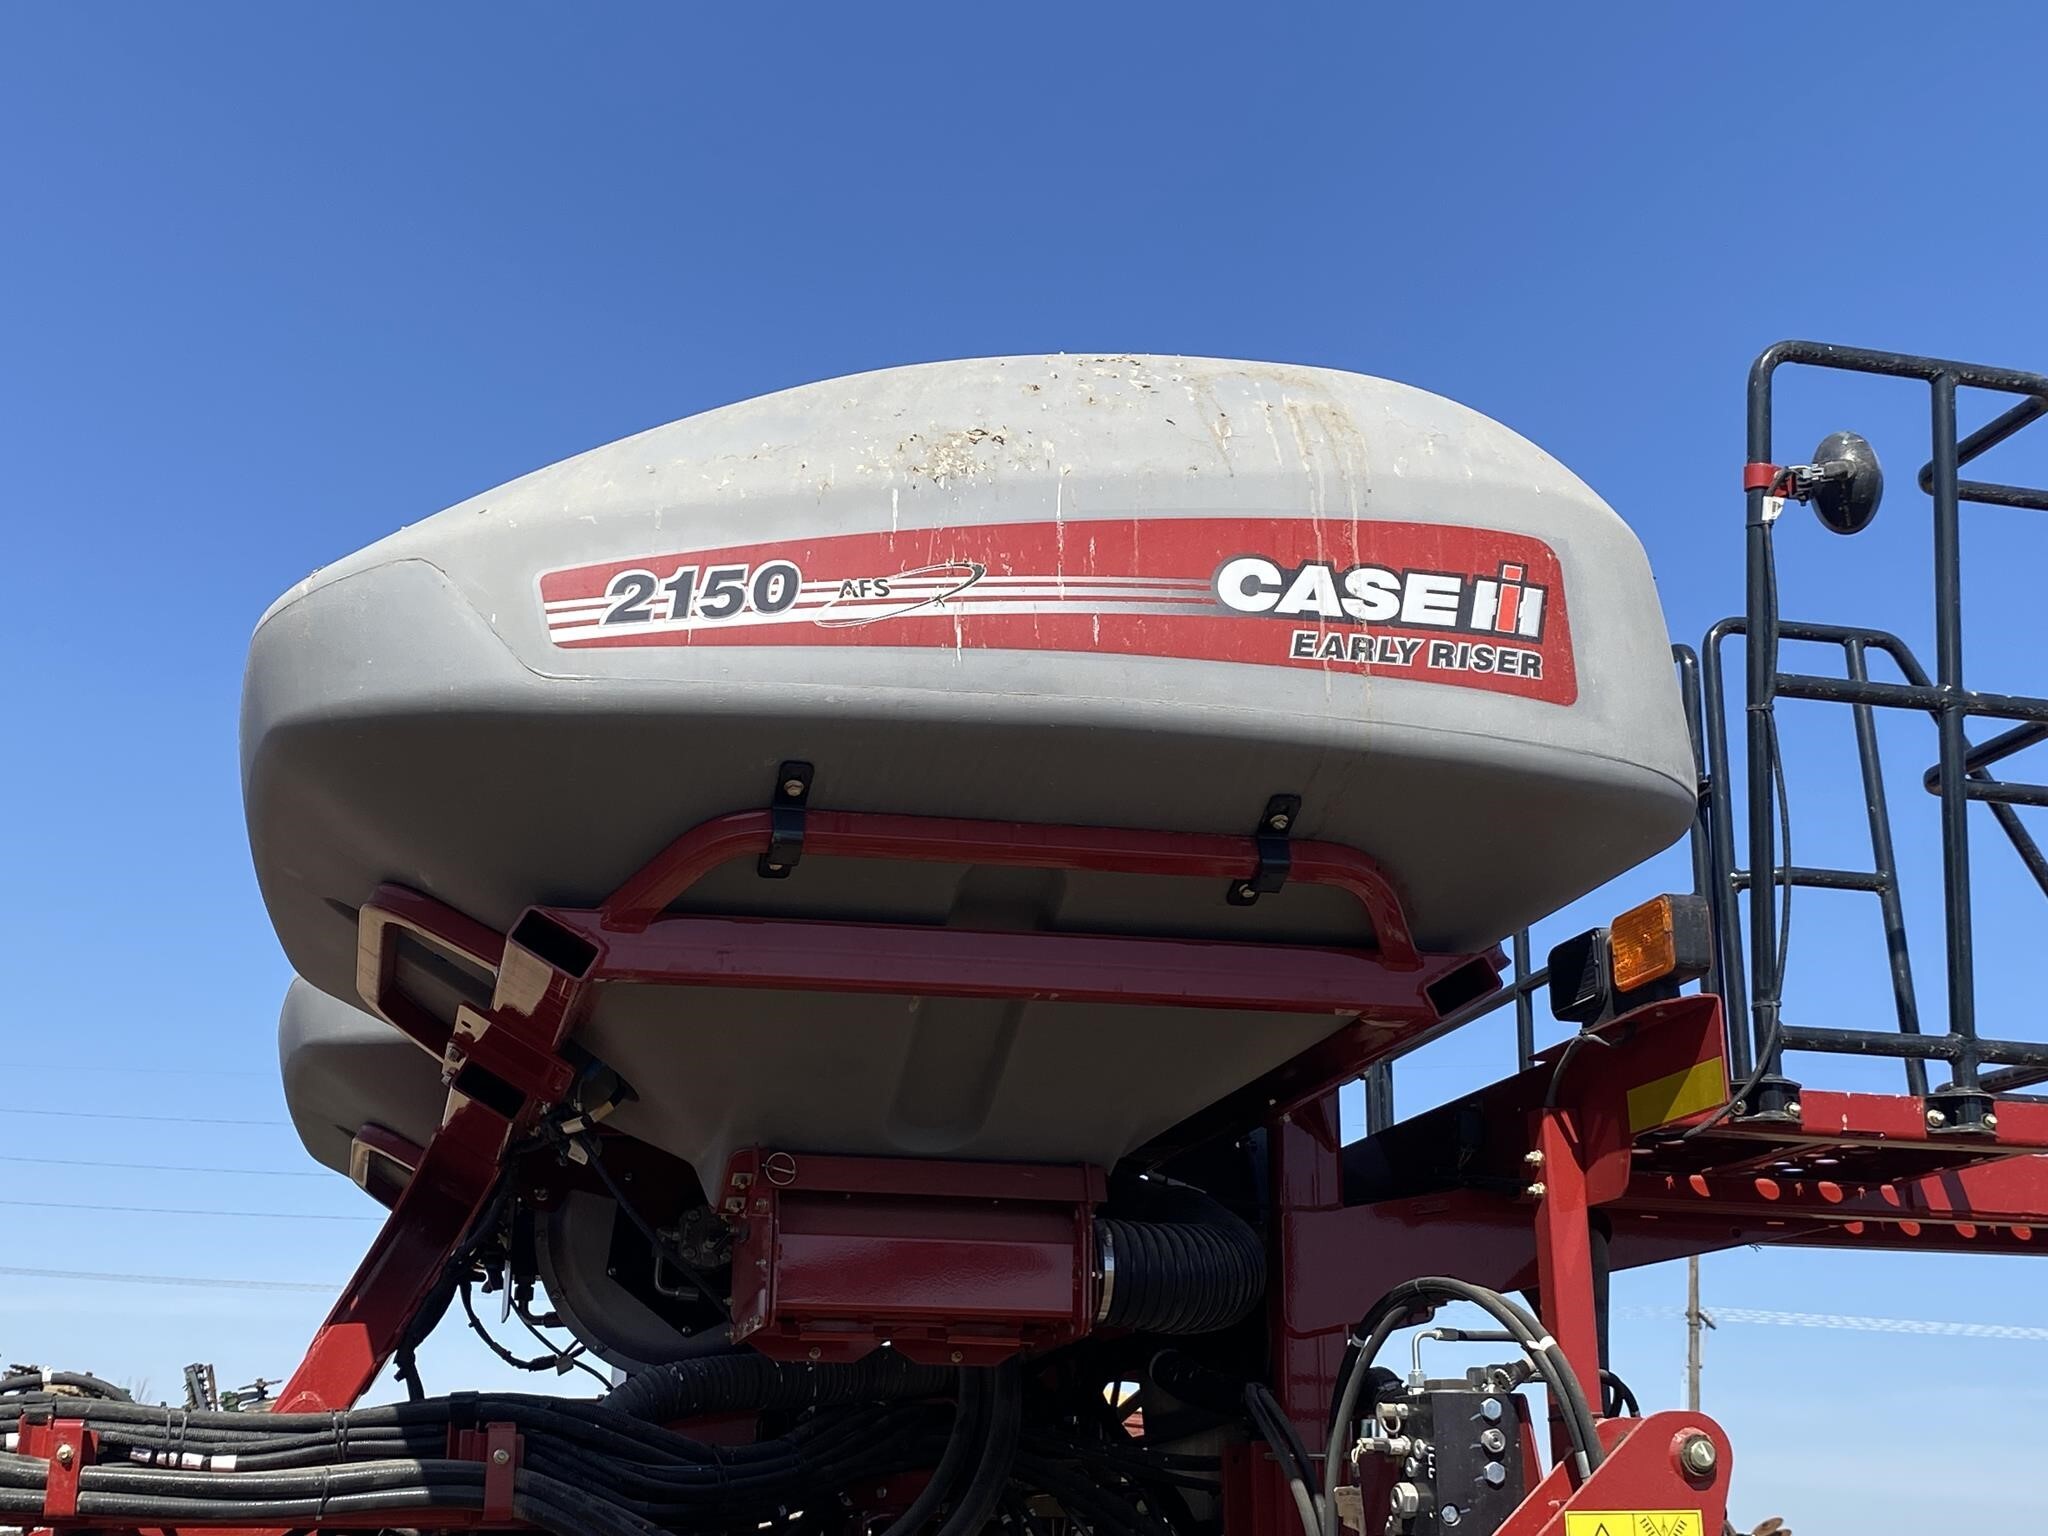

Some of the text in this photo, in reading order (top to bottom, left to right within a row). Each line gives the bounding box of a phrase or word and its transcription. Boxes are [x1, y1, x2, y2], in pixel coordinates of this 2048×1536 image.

[603, 561, 800, 625] 2150
[839, 578, 890, 598] AFS
[1217, 558, 1462, 627] CASE
[1290, 630, 1543, 680] EARLY RISER
